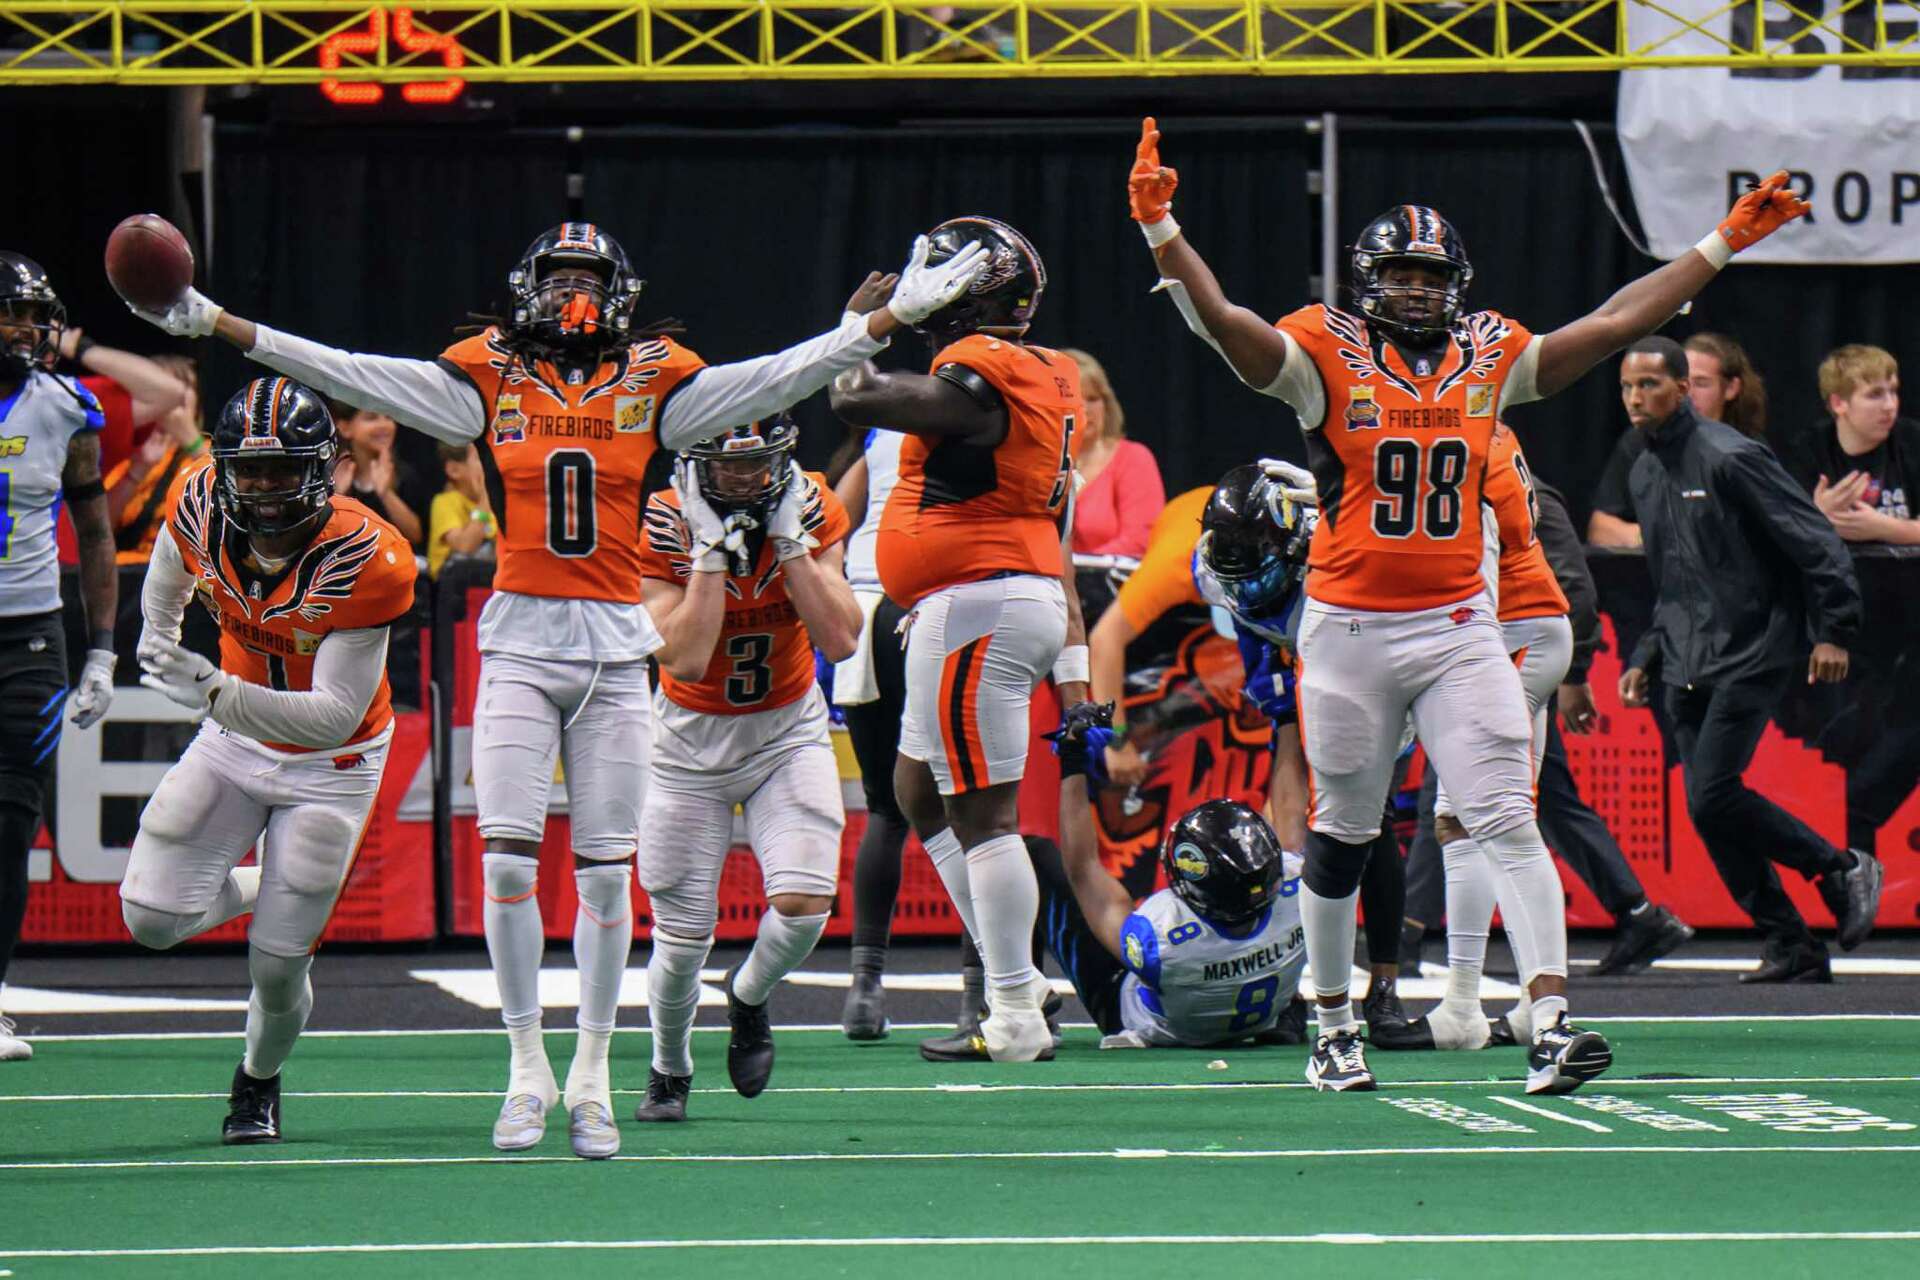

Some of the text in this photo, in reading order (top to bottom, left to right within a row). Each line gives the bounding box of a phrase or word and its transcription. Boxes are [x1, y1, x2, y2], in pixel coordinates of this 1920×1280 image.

[319, 5, 465, 104] 25
[528, 414, 614, 441] FIREBIRDS
[1388, 407, 1462, 429] FIREBIRDS
[544, 447, 597, 559] 0
[1371, 436, 1469, 540] 98
[223, 611, 296, 655] FIREBIRDS
[725, 632, 775, 707] 3
[1167, 919, 1202, 946] 8
[1203, 942, 1283, 981] MAXWELL
[1229, 973, 1280, 1033] 8
